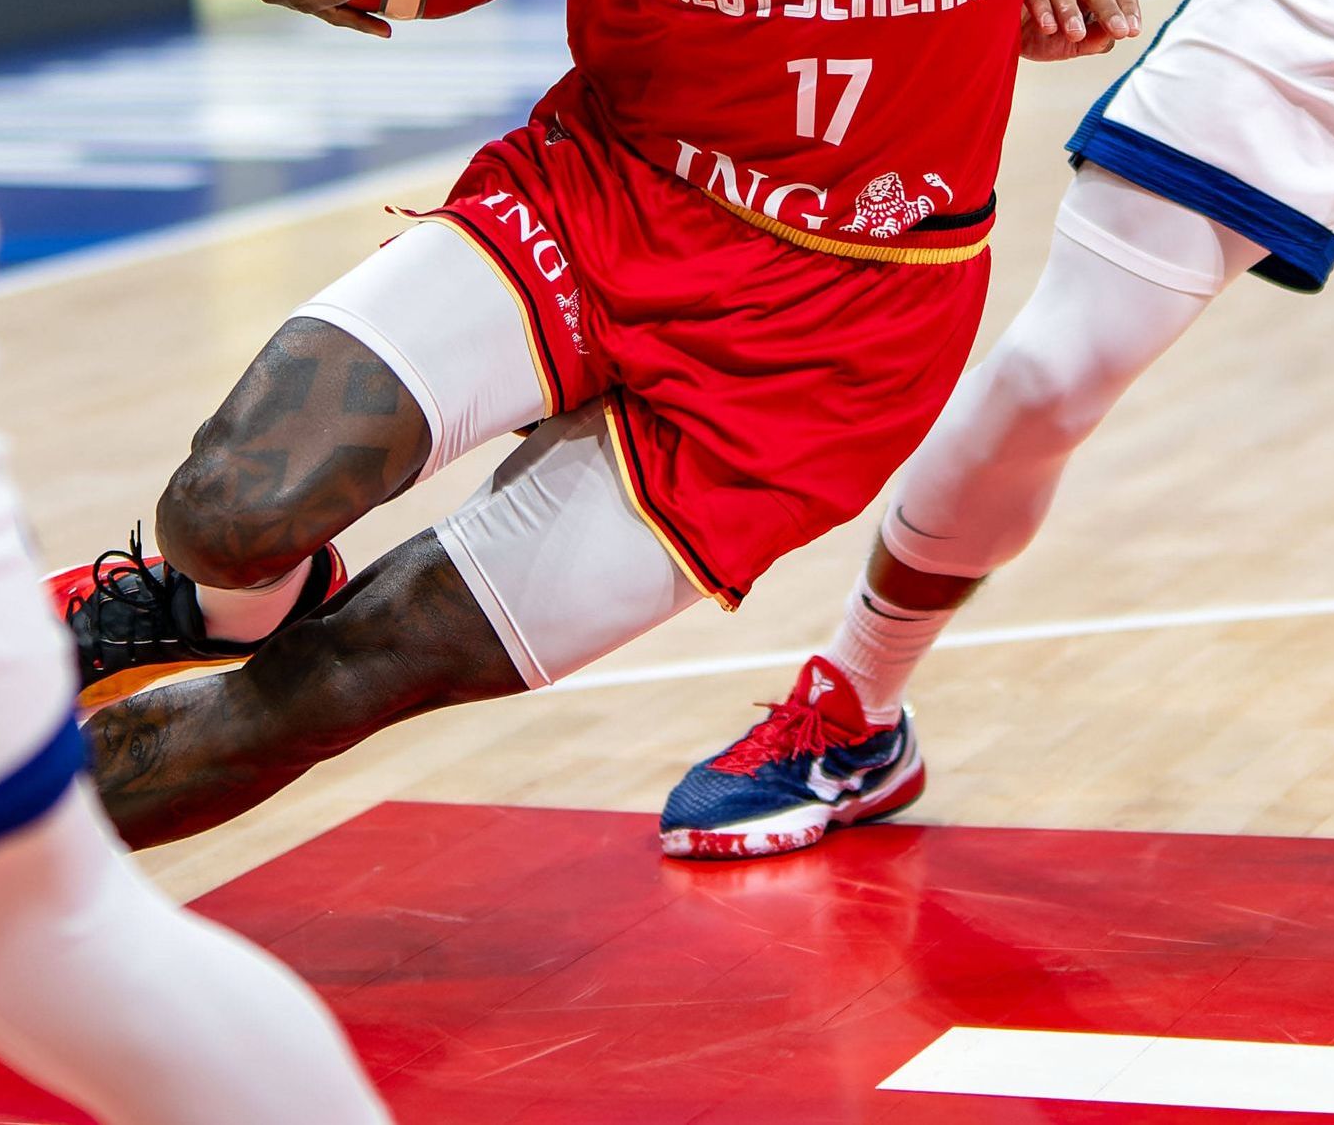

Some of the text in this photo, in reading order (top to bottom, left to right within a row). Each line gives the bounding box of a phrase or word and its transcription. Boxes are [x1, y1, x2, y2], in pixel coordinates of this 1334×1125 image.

[786, 57, 873, 147] 17
[675, 139, 829, 230] ING
[479, 189, 569, 283] ING
